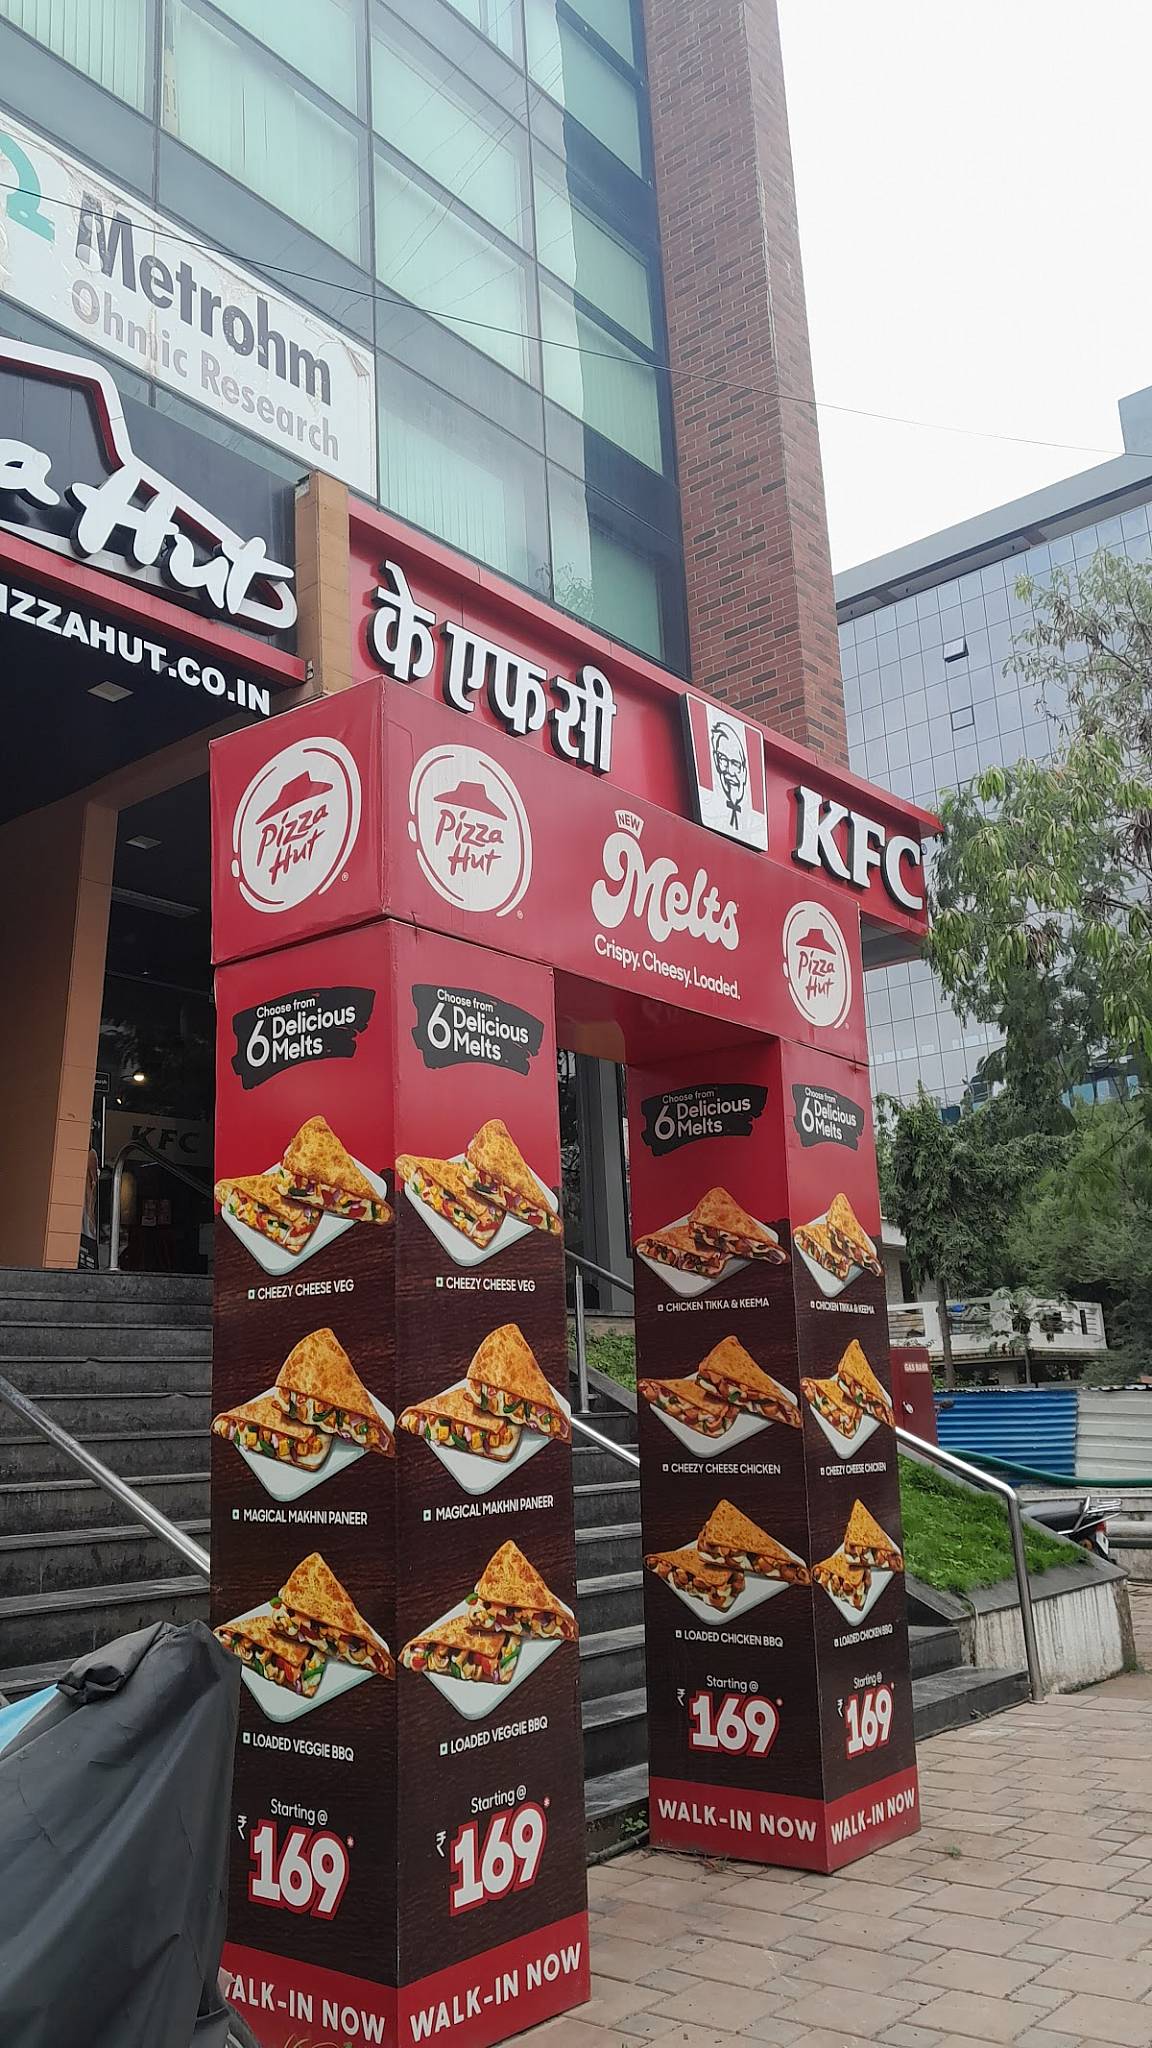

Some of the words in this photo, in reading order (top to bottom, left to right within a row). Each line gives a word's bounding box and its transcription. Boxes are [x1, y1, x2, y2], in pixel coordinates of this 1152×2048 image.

[75, 190, 331, 406] Metrohm
[200, 349, 339, 461] Research
[70, 464, 298, 629] Hut
[257, 803, 329, 866] Pizza
[435, 808, 505, 846] Pizza
[616, 813, 641, 832] NEW
[269, 827, 326, 885] Hut
[447, 847, 502, 876] Hut
[795, 784, 923, 911] KFC
[591, 832, 740, 951] Melts
[594, 934, 641, 971] Crispy.
[642, 950, 692, 987] Cheesy.
[693, 967, 741, 1000] Loaded.
[797, 949, 836, 979] Pizza
[437, 988, 472, 1007] Choose
[473, 998, 494, 1013] from
[805, 978, 835, 1000] Hut
[256, 1003, 292, 1019] Choose
[293, 998, 316, 1011] from
[246, 1020, 270, 1067] 6
[272, 1006, 356, 1039] Delicious
[427, 1002, 451, 1049] 6
[453, 1005, 529, 1044] Delicious
[272, 1035, 323, 1063] Melts
[453, 1029, 502, 1061] Melts
[662, 1093, 693, 1104] Choose
[694, 1090, 715, 1099] from
[654, 1105, 676, 1140] 6
[676, 1098, 751, 1120] Delicious
[677, 1117, 723, 1137] Melts
[801, 1097, 815, 1133] 6
[814, 1099, 857, 1127] Delicious
[815, 1117, 843, 1140] Melts
[132, 1125, 200, 1154] KFC
[257, 1285, 293, 1300] CHEEZY
[295, 1281, 332, 1296] CHEESE
[333, 1279, 354, 1293] VEG
[446, 1277, 481, 1290] CHEEZY
[483, 1278, 517, 1291] CHEESE
[517, 1280, 536, 1292] VEG
[666, 1301, 704, 1312] CHICKEN
[704, 1299, 730, 1310] TIKKA
[731, 1299, 738, 1309] &
[739, 1298, 770, 1308] KEEMA
[671, 1463, 704, 1473] CHEEZY
[705, 1463, 739, 1474] CHEESE
[740, 1463, 781, 1474] CHICKEN
[243, 1509, 287, 1523] MAGICAL
[288, 1510, 328, 1524] MAKHNI
[328, 1511, 368, 1525] PANEER
[435, 1503, 481, 1521] MAGICAL
[482, 1499, 519, 1515] MAKHNI
[520, 1495, 554, 1511] PANEER
[684, 1630, 720, 1642] LOADED
[720, 1632, 762, 1645] CHICKEN
[762, 1636, 784, 1647] BBQ
[706, 1675, 748, 1693] Starting
[749, 1680, 759, 1693] @
[853, 1673, 877, 1689] Starting
[252, 1733, 292, 1751] LOADED
[293, 1739, 331, 1758] VEGGIE
[331, 1745, 354, 1761] BBQ
[450, 1731, 490, 1754] LOADED
[491, 1721, 527, 1742] VEGGIE
[528, 1716, 548, 1733] BBQ
[271, 1798, 315, 1826] Starting
[317, 1809, 328, 1826] @
[471, 1789, 515, 1814] Starting
[516, 1785, 527, 1801] @
[658, 1798, 752, 1832] WALK-IN
[760, 1813, 817, 1842] NOW
[830, 1802, 885, 1845] WALK-IN
[887, 1788, 915, 1820] NOW
[410, 1969, 519, 2042] WALK-IN
[526, 1942, 582, 1991] NOW
[322, 1999, 386, 2044] NOW
